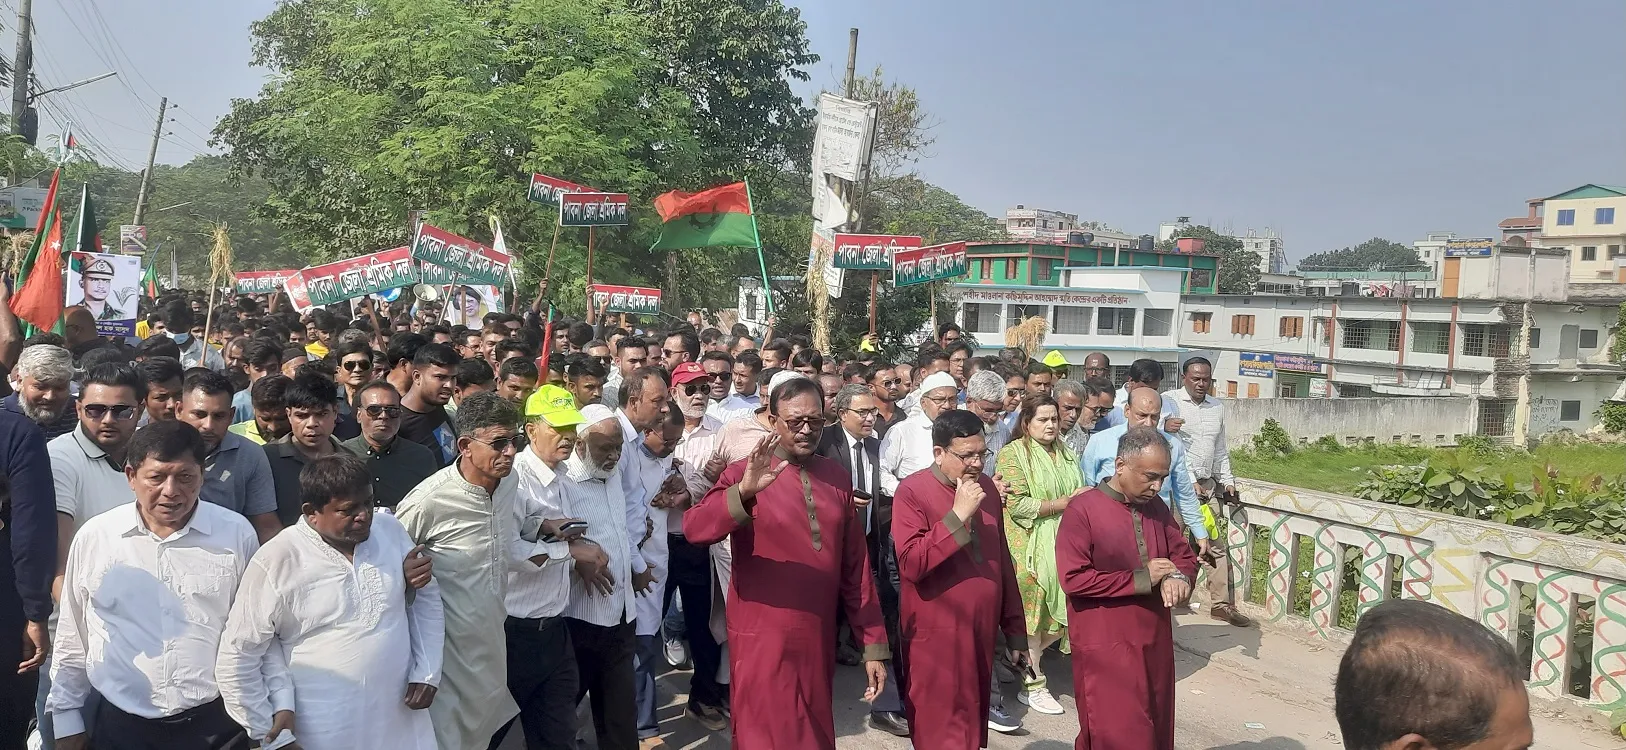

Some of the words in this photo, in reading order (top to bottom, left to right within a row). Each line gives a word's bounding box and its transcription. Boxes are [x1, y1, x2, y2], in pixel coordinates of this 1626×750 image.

[533, 181, 552, 201] পাবনা
[564, 201, 582, 221] পাবনা
[583, 202, 599, 221] জেলা
[600, 196, 616, 222] শ্রমিক
[617, 202, 627, 221] দল
[420, 233, 446, 260] পাবনা
[444, 244, 468, 268] জেলা
[466, 246, 492, 275] শ্রমিক
[492, 259, 506, 282] দল
[838, 242, 861, 266] পাবনা
[862, 245, 882, 265] জেলা
[896, 257, 915, 281] পাবনা
[918, 257, 935, 279] জেলা
[935, 247, 954, 275] শ্রমিক
[955, 251, 966, 271] দল
[238, 277, 255, 291] পাবনা
[256, 276, 271, 290] জেলা
[308, 272, 340, 301] পাবনা
[339, 265, 367, 294] জেলা
[364, 256, 394, 291] শ্রমিক
[393, 258, 414, 282] দল
[611, 290, 627, 309] জেলা
[628, 289, 646, 310] শ্রমিক
[648, 295, 659, 311] দল
[981, 291, 1004, 301] মাওলানা
[1092, 293, 1107, 304] একটি
